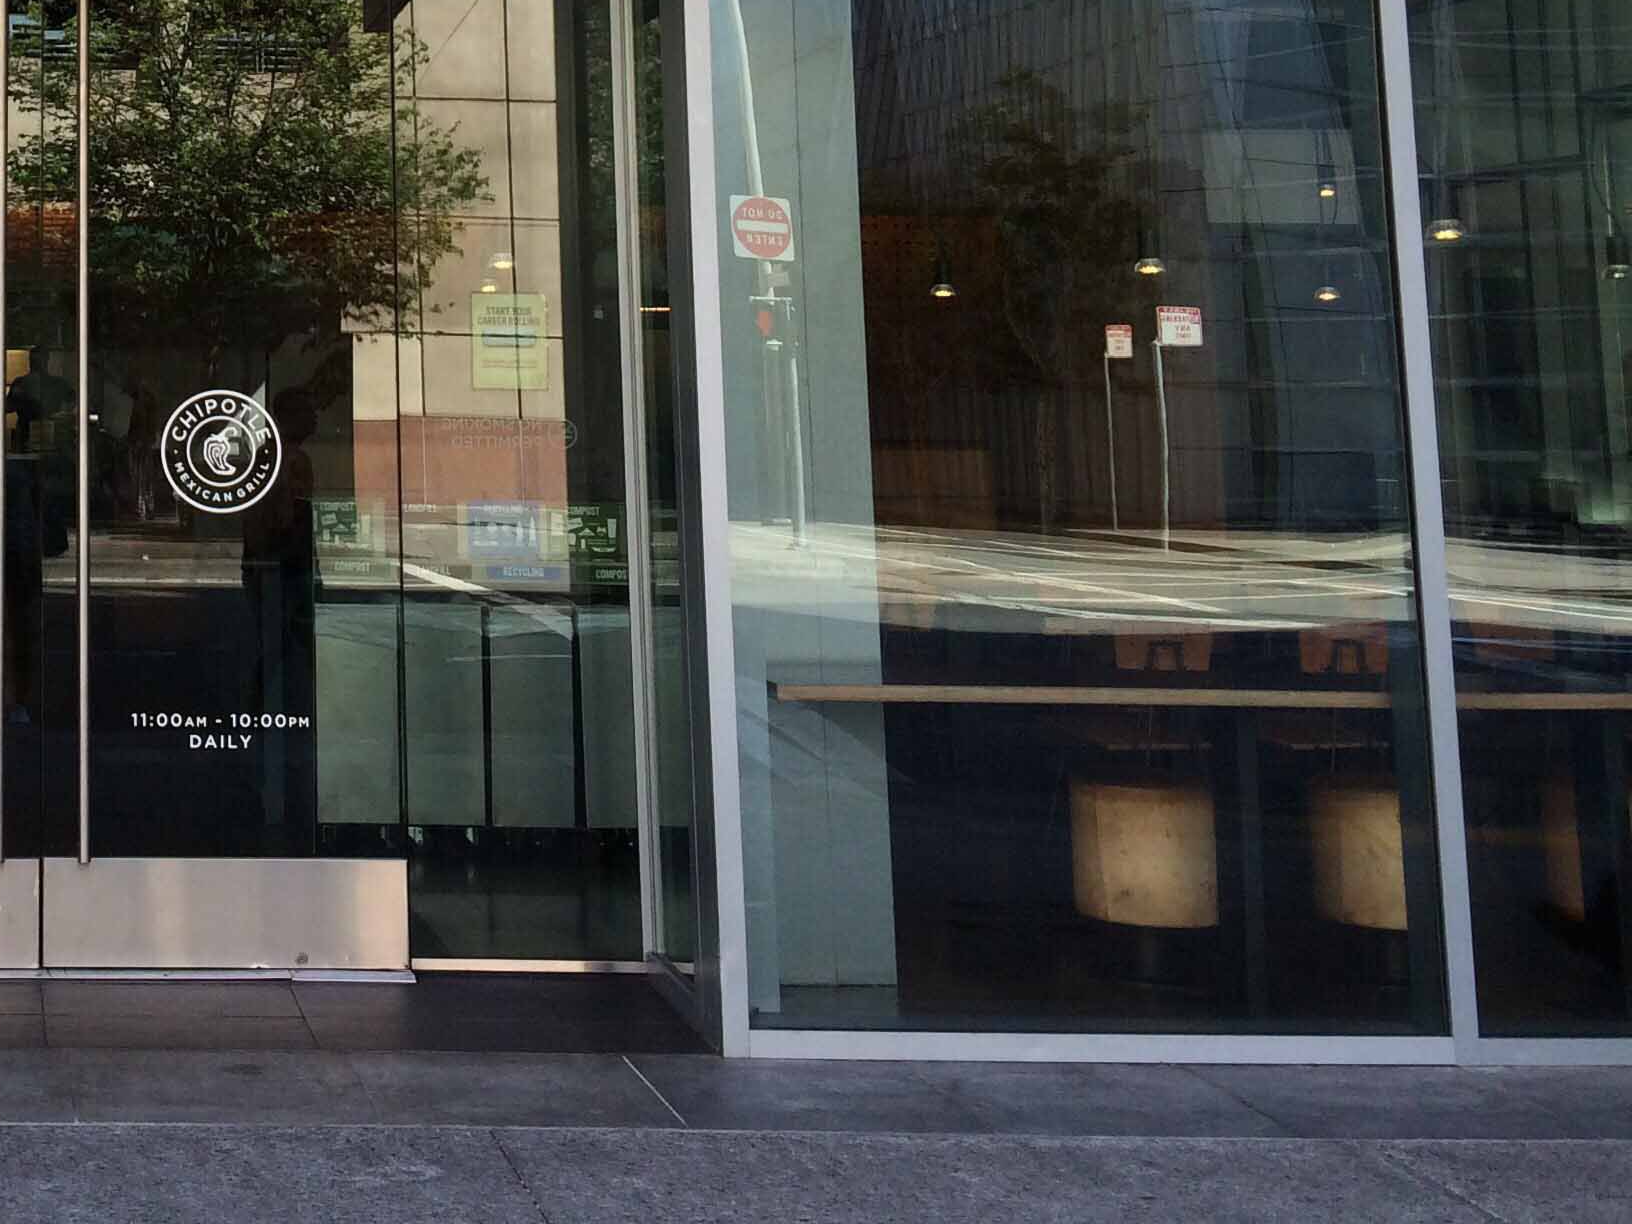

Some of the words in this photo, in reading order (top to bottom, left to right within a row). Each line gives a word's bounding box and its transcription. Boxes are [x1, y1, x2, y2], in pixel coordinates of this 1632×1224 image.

[172, 398, 272, 444] CHIPOTLE
[174, 462, 233, 502] MEXICAN
[236, 462, 270, 498] GRILL
[130, 713, 207, 728] 11:00AM
[230, 713, 310, 728] 10:00PM
[189, 734, 253, 749] DAILY
